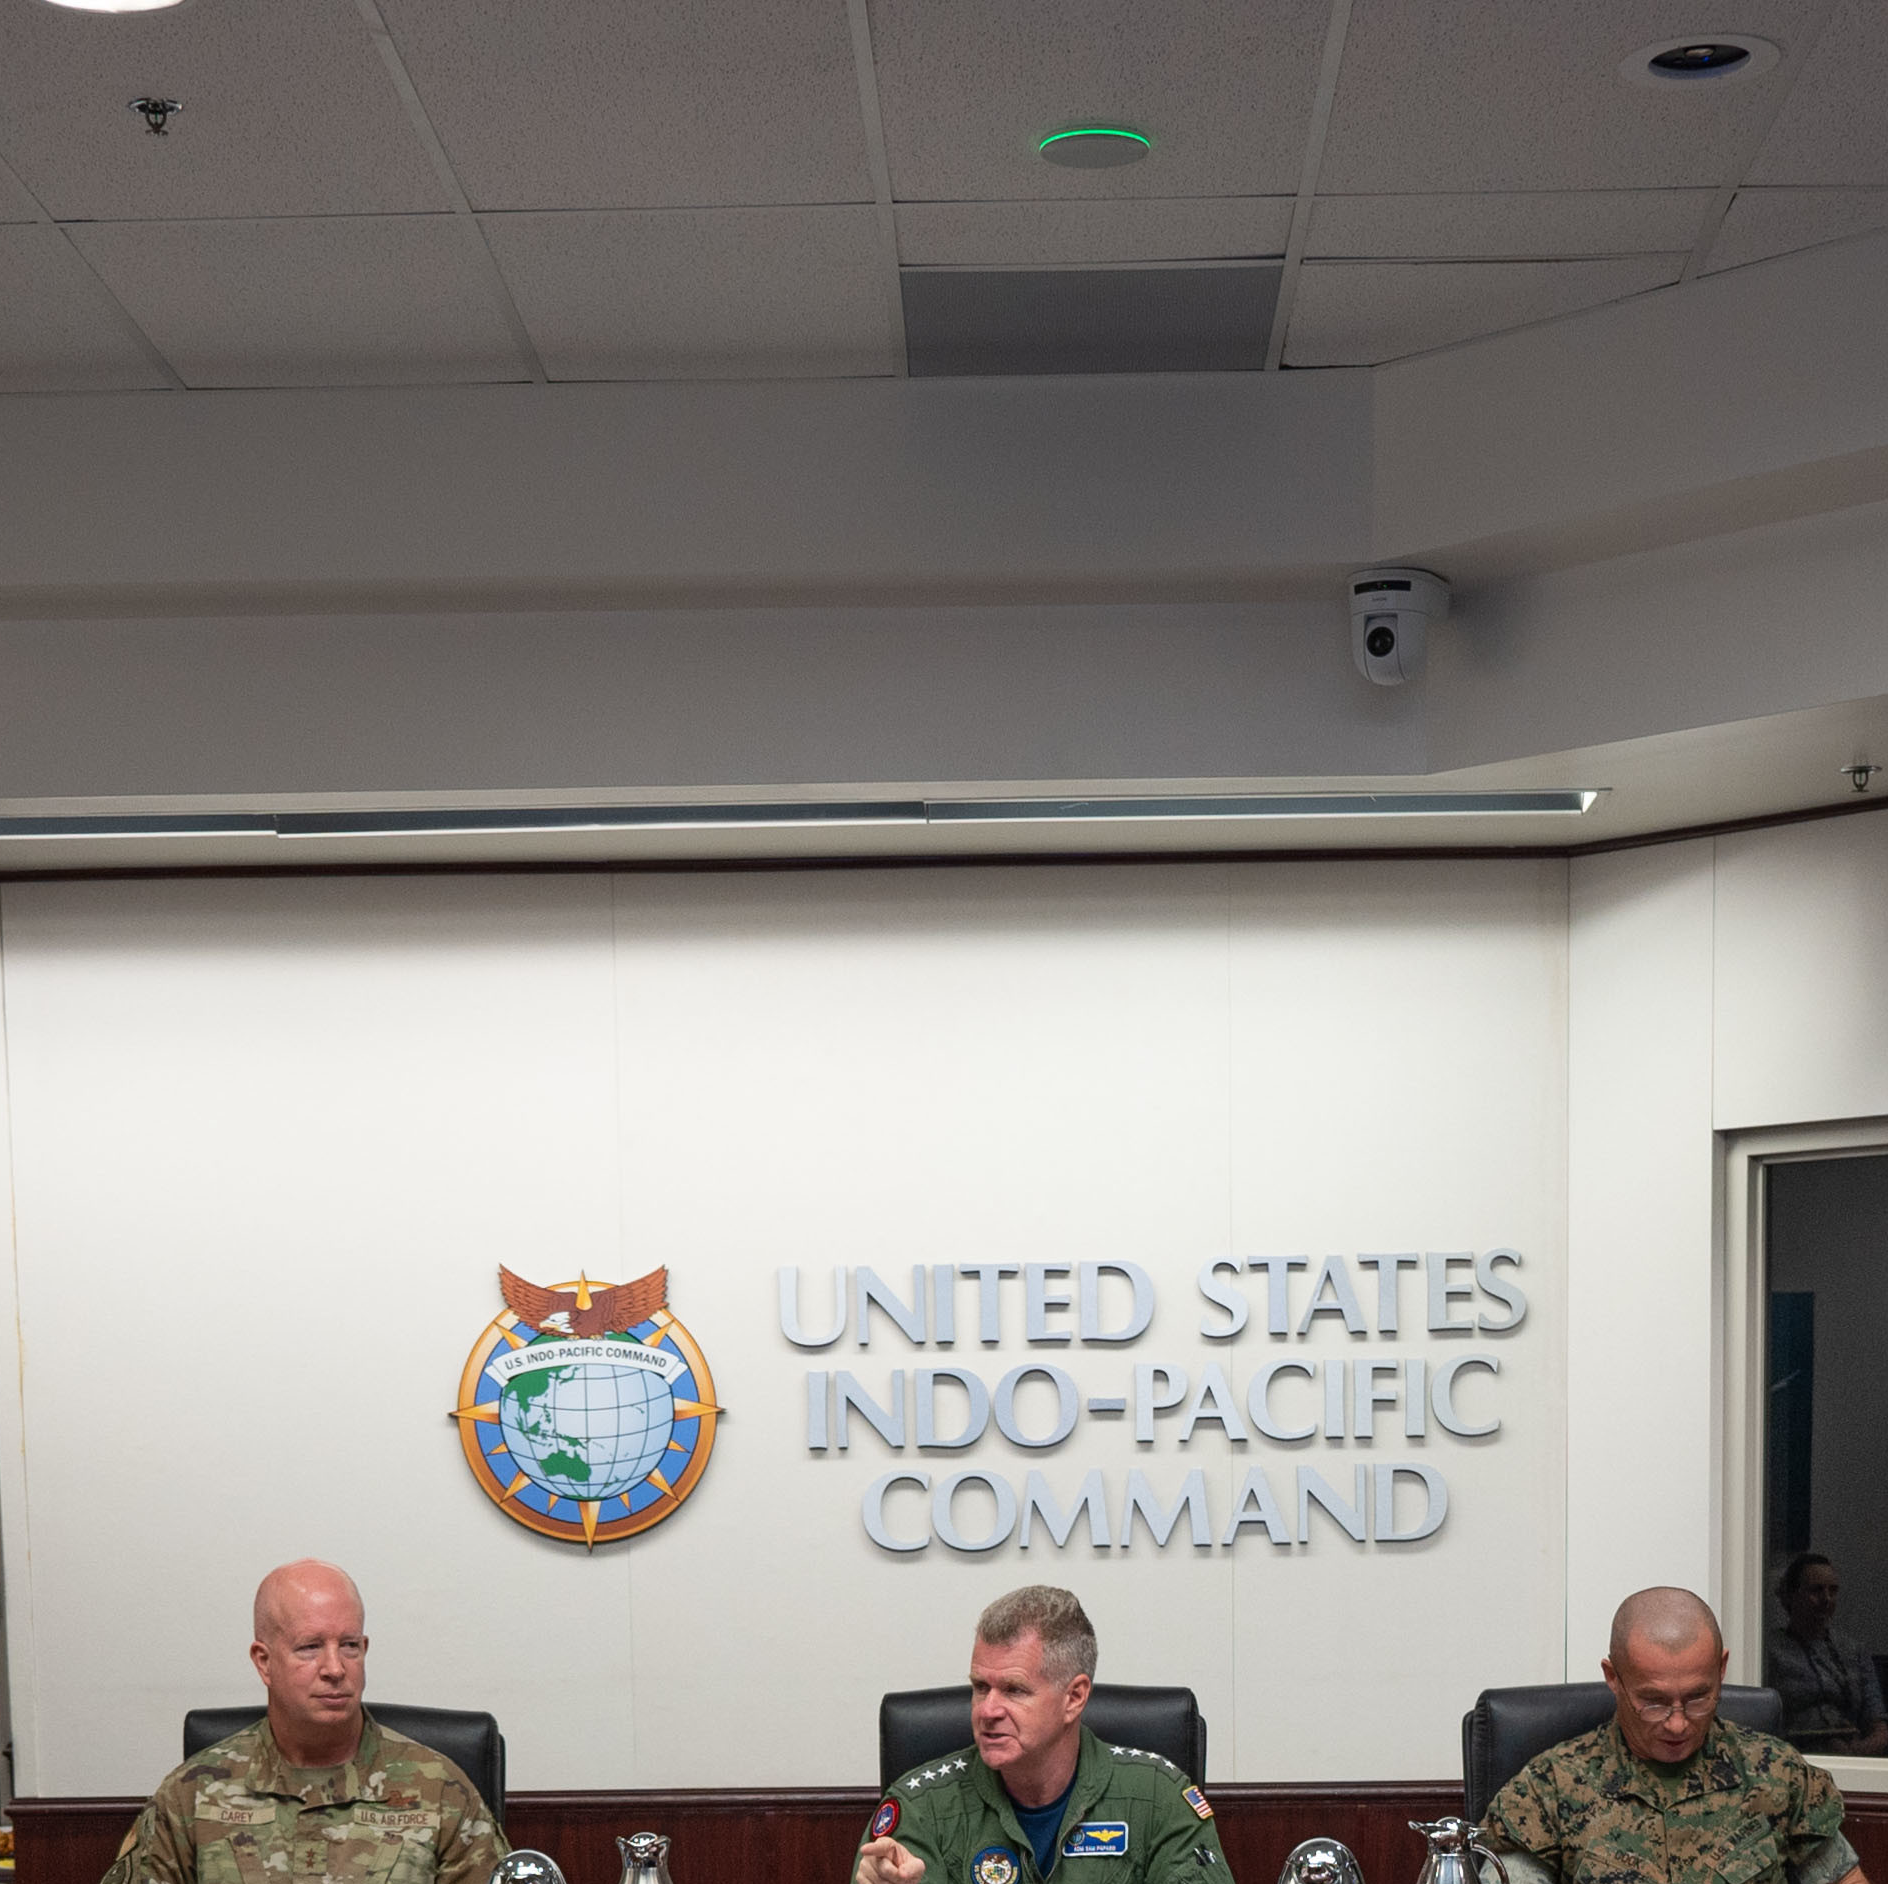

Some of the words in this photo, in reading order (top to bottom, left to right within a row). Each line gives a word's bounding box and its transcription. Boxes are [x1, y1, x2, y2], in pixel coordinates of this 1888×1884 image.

[777, 1260, 1156, 1350] UNITED
[1198, 1248, 1528, 1341] STATES
[504, 1359, 524, 1371] U.S.
[527, 1346, 604, 1366] INDO-PACIFIC
[605, 1347, 667, 1369] COMMAND
[806, 1353, 1504, 1455] INDO-PACIFIC
[862, 1461, 1449, 1553] COMMAND
[220, 1810, 254, 1823] CAREY
[361, 1810, 378, 1824] U.S.
[380, 1812, 396, 1826] AIR
[397, 1813, 429, 1826] FORCE
